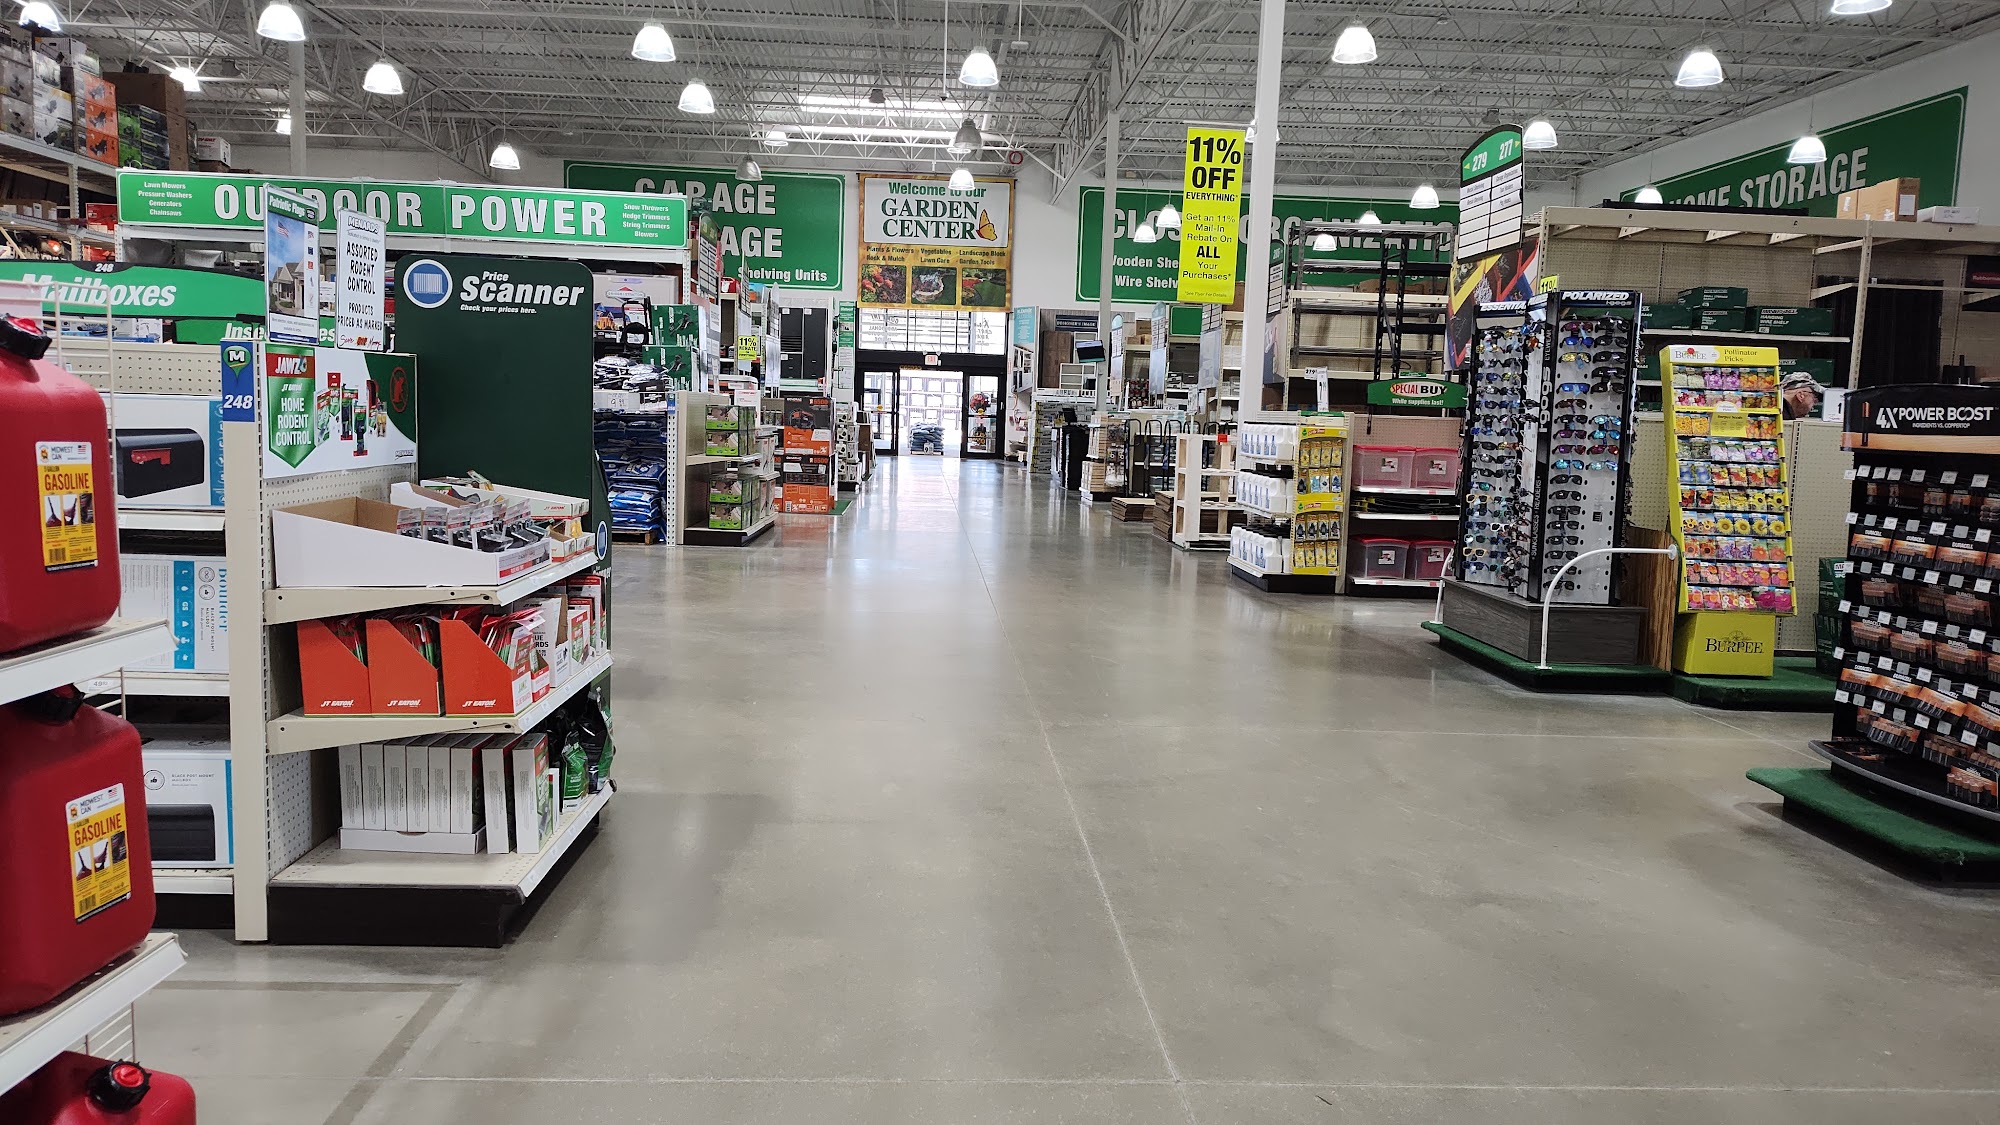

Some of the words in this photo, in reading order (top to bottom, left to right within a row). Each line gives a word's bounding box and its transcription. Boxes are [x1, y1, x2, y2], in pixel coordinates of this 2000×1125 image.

[1189, 136, 1241, 165] 11%
[1472, 151, 1488, 172] 279
[1499, 139, 1514, 161] 277
[1192, 166, 1236, 190] OFF
[1669, 184, 1731, 207] ME
[1739, 147, 1869, 208] STORAGE
[138, 190, 165, 198] Pressure
[166, 191, 193, 199] Washers
[888, 182, 946, 196] Welcome
[149, 200, 182, 208] Generators
[214, 184, 423, 228] OUDOOR
[451, 194, 608, 236] POWER
[269, 195, 292, 212] Patriotic
[292, 203, 305, 217] Flags
[641, 204, 669, 212] Throwers
[881, 198, 979, 220] GARDEN
[622, 212, 641, 220] Hedge
[642, 213, 670, 221] Trimmers
[1186, 213, 1201, 222] Get
[1218, 215, 1236, 224] 11%
[347, 215, 380, 235] MENARDS
[622, 221, 641, 229] String
[642, 222, 670, 230] Trimmers
[882, 218, 977, 240] CENTER
[1195, 224, 1225, 233] Mail-In
[634, 230, 659, 238] Blowers
[1187, 233, 1218, 242] Rebate
[1220, 235, 1232, 243] On
[346, 241, 378, 262] ASSORTED
[1196, 245, 1221, 259] ALL
[94, 263, 114, 273] 248
[350, 259, 375, 278] RODENT
[1113, 255, 1153, 268] ooden
[1197, 261, 1218, 270] Your
[482, 271, 509, 282] Price
[795, 269, 828, 283] Units
[1115, 275, 1142, 288] Wire
[1146, 276, 1179, 289] Shelv
[22, 273, 177, 307] Mailboxes
[347, 276, 376, 295] CONTROL
[460, 275, 585, 306] Scanner
[1561, 291, 1630, 301] POLARIZED
[348, 302, 374, 316] PRODUCTS
[460, 303, 480, 312] Check
[482, 305, 497, 313] your
[498, 306, 519, 314] prices
[520, 306, 537, 314] here.
[337, 315, 355, 328] PRICED
[355, 319, 363, 329] AS
[363, 319, 383, 331] MARKED
[739, 337, 757, 347] 11%
[1724, 348, 1758, 357] Pollinator
[1391, 383, 1419, 395] SPECIAL
[1420, 385, 1448, 395] BUY
[223, 394, 254, 410] 248
[280, 397, 305, 412] HOME
[277, 415, 309, 430] RODENT
[1875, 407, 1899, 429] 4X
[1899, 407, 1945, 421] POWER
[1947, 406, 1994, 422] BOOST
[275, 430, 312, 447] CONTROL
[50, 446, 73, 454] MIDWEST
[44, 472, 90, 491] GASOLINE
[1704, 637, 1765, 654] BURPEE
[1981, 701, 2000, 715] DURACEL
[79, 794, 104, 807] MIDWEST
[80, 806, 92, 815] CAN
[74, 812, 122, 847] GASOLINE
